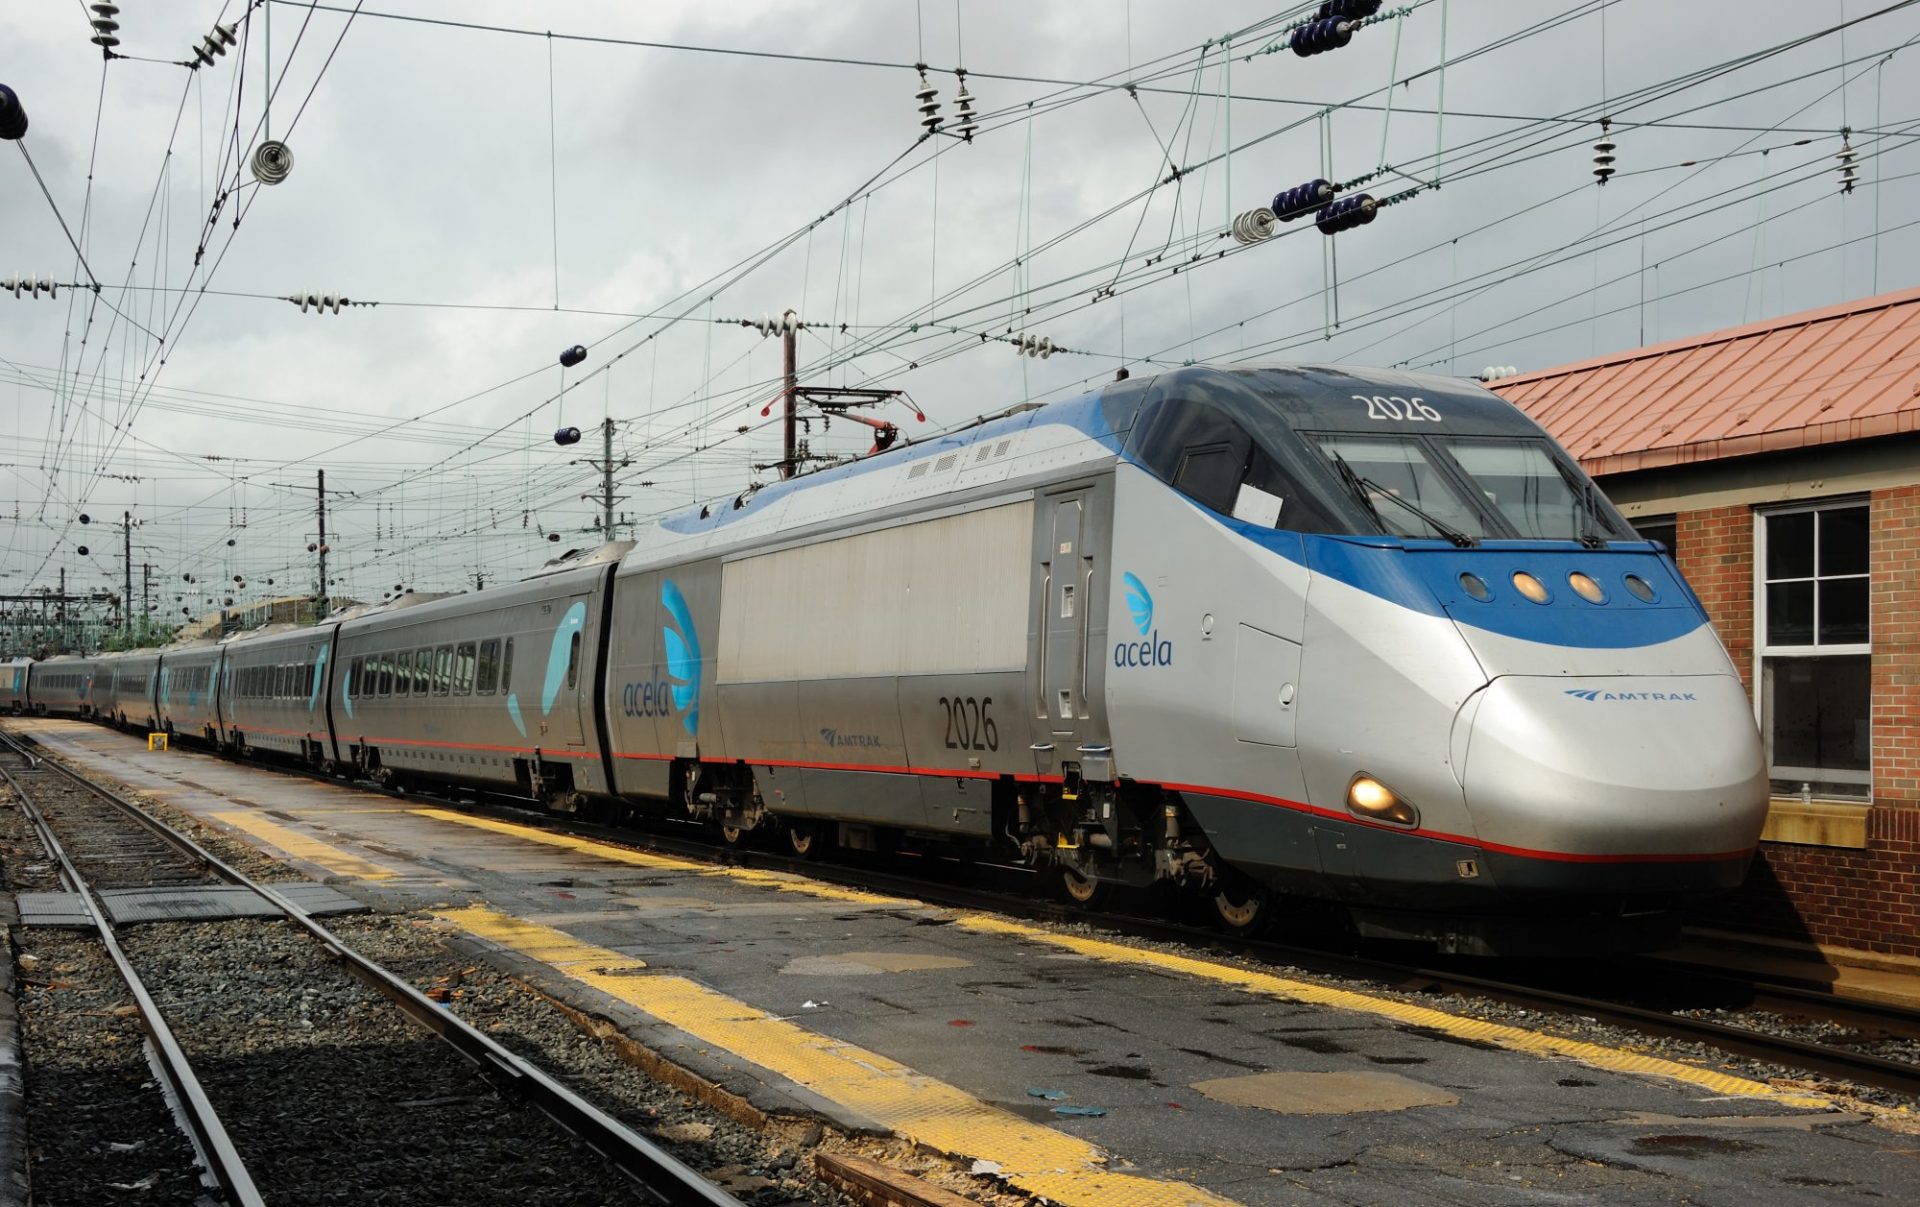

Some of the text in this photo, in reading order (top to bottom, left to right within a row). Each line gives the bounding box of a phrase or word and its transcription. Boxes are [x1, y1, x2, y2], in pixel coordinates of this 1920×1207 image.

[1352, 394, 1442, 422] 2026
[1115, 629, 1172, 668] acela
[623, 668, 670, 717] acela
[1603, 692, 1697, 703] AMTRAK
[938, 696, 999, 752] 2026
[836, 734, 881, 748] AMTRAK
